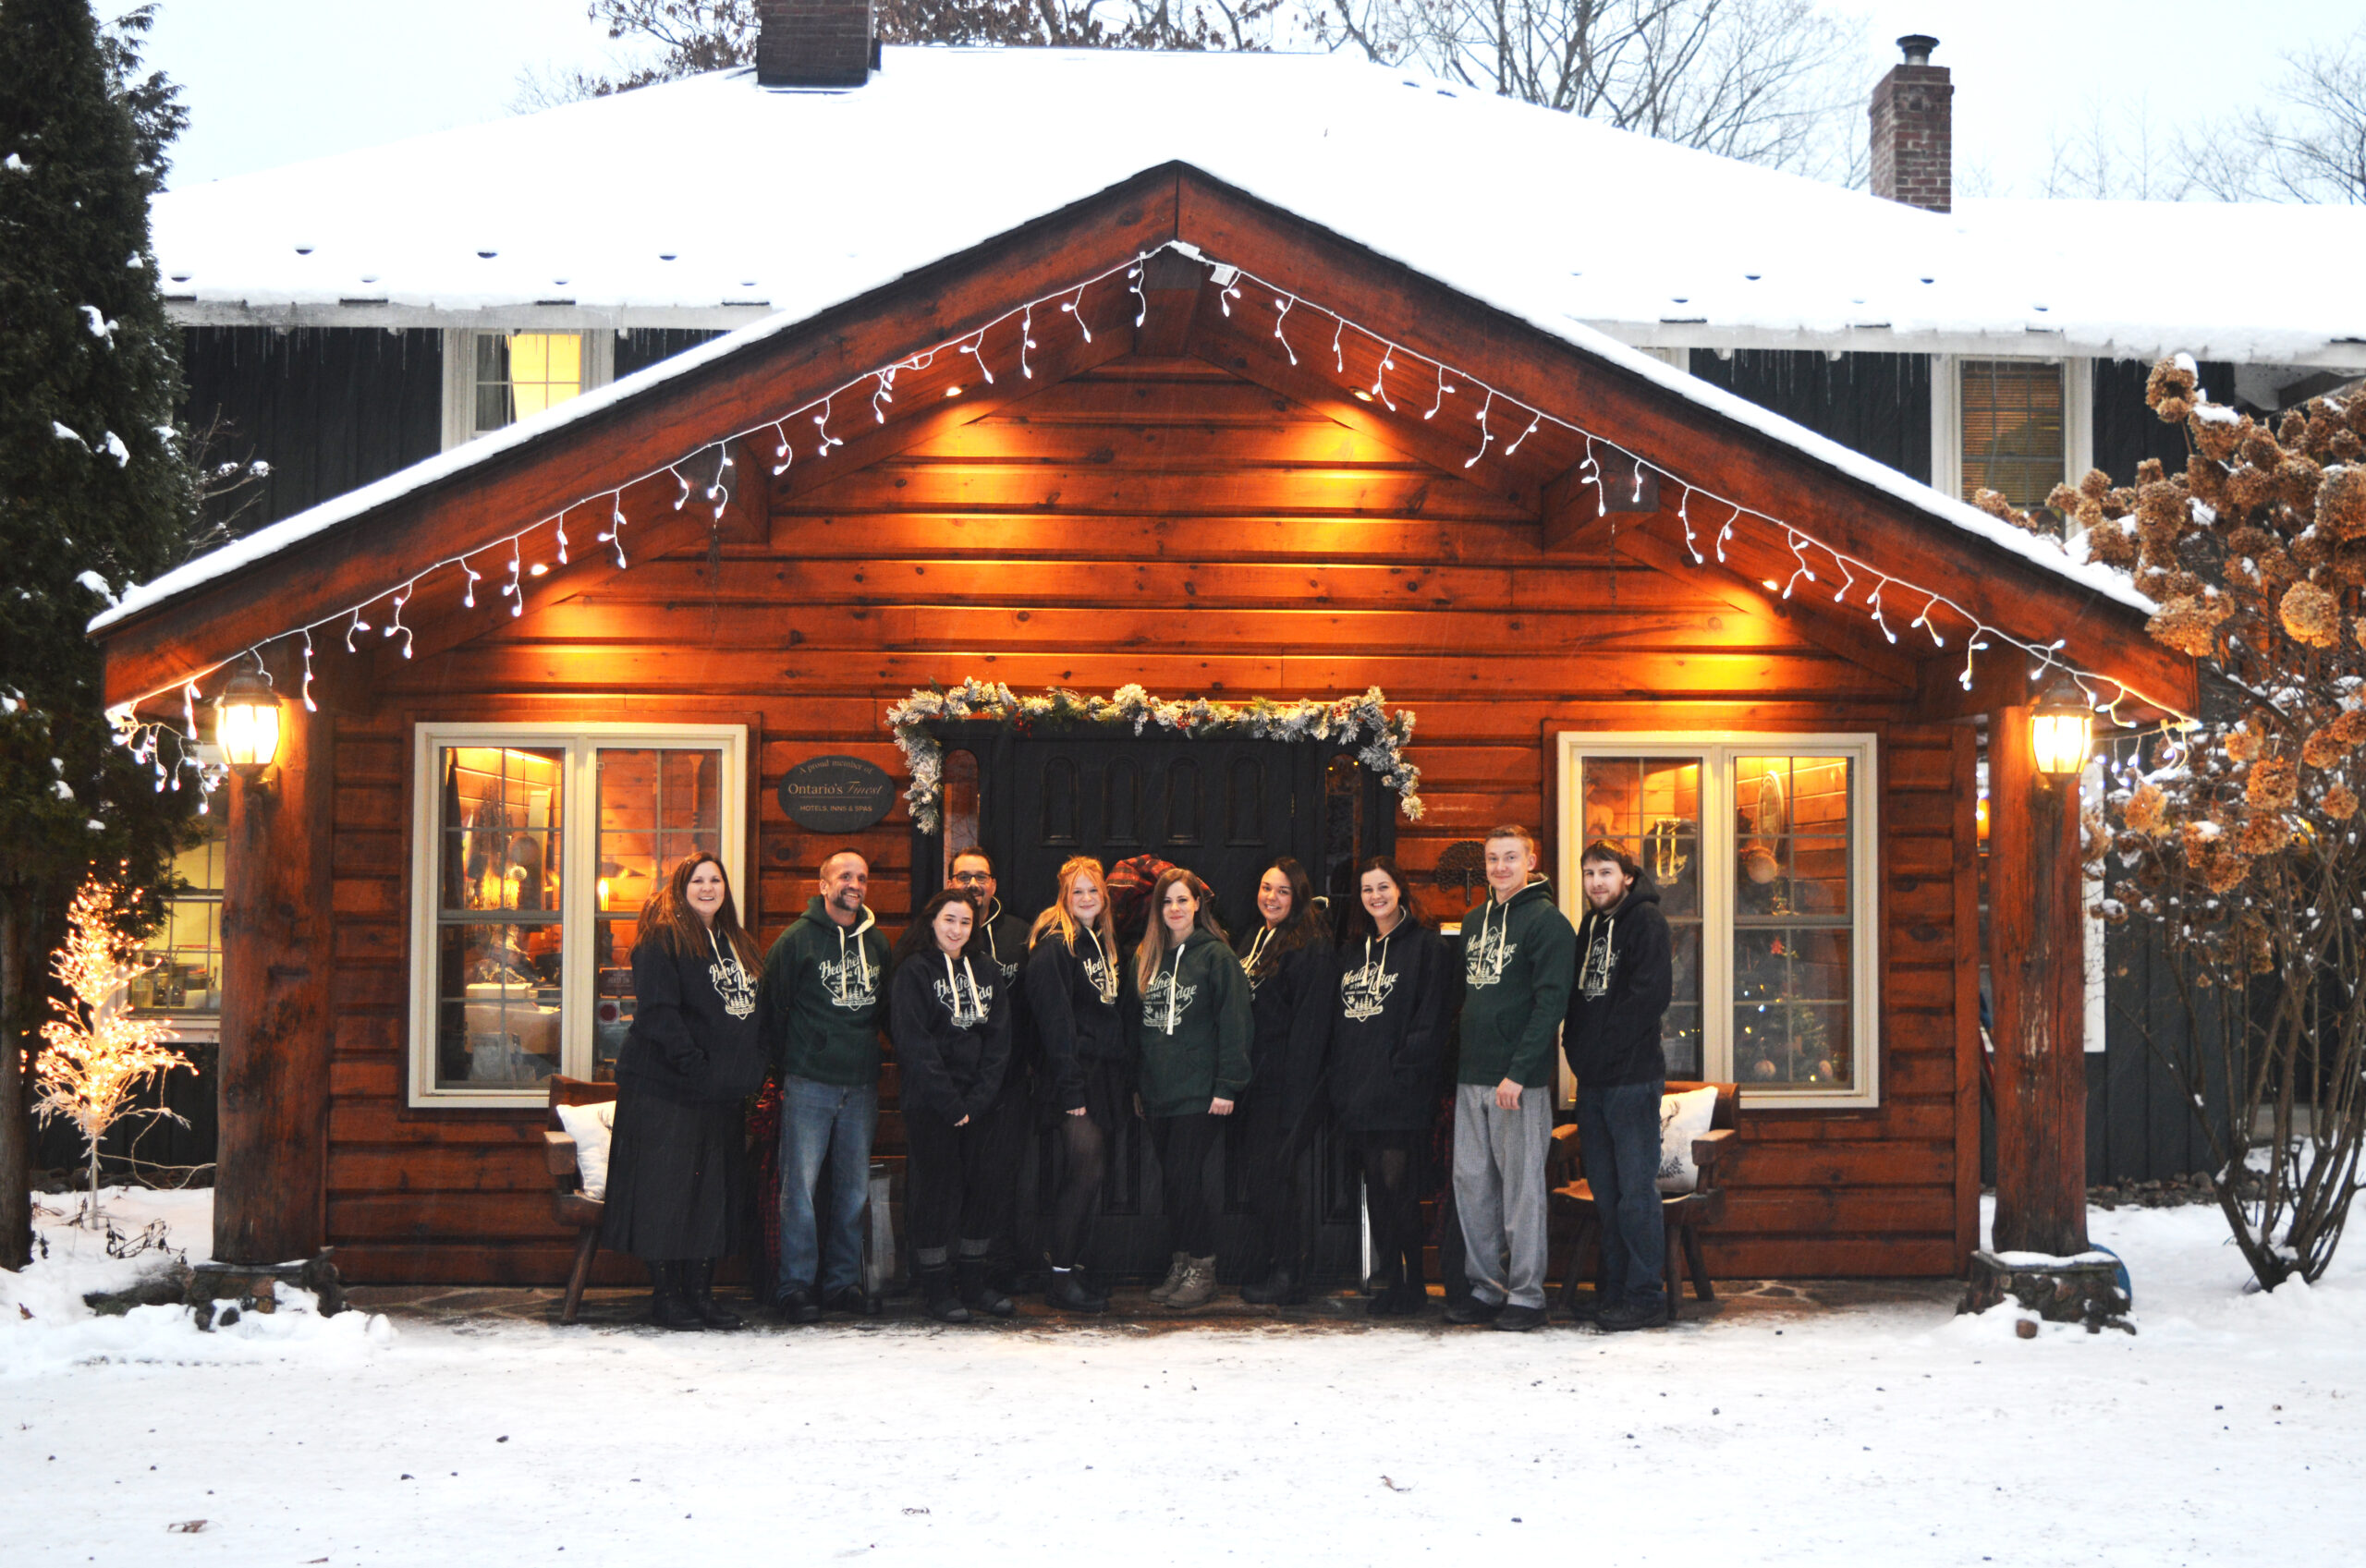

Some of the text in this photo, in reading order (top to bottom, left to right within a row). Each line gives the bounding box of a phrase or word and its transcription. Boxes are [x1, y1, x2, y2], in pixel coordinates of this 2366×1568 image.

[787, 781, 884, 796] Ontario's Finest
[1163, 985, 1198, 1005] Ldge
